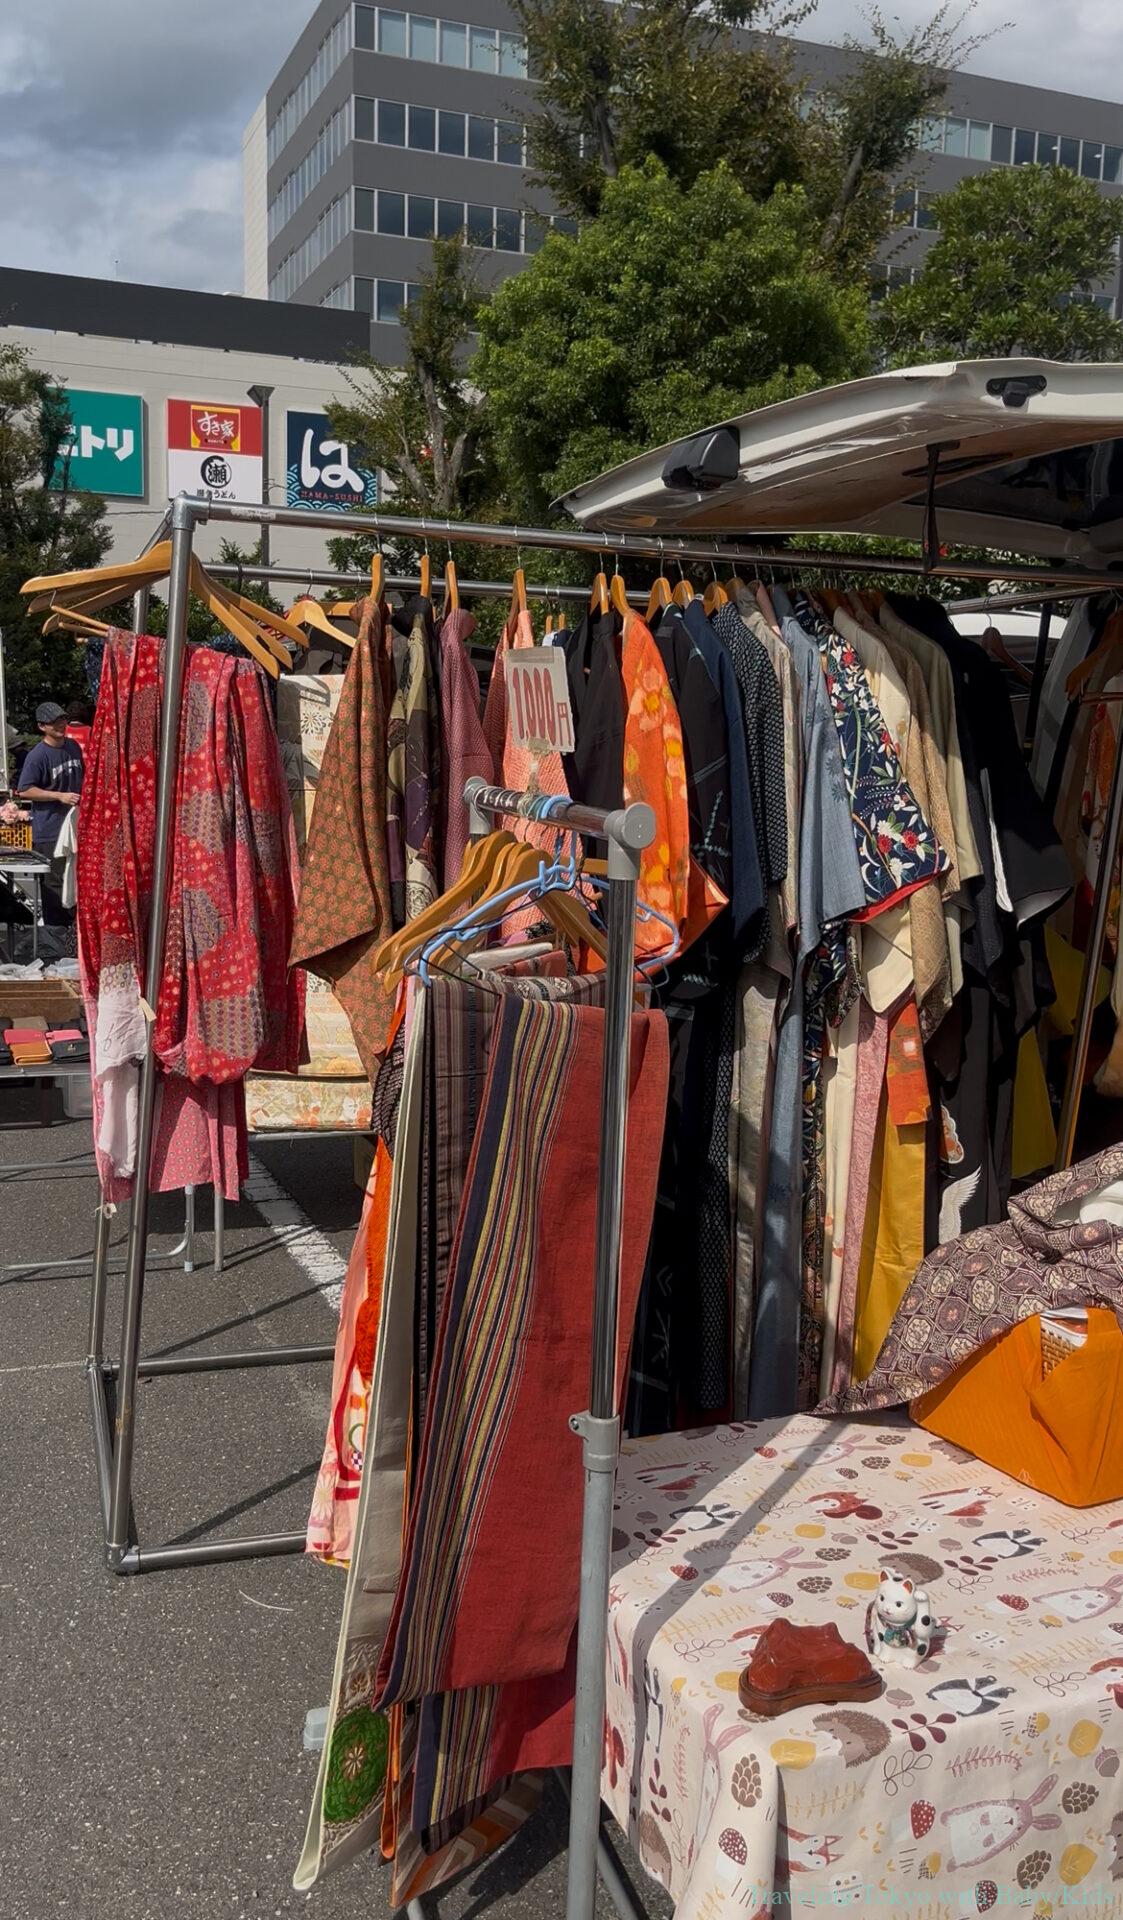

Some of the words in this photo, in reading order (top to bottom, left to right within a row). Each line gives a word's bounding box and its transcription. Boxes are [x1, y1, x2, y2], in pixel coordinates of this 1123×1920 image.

[197, 411, 235, 440] すき家
[301, 428, 365, 493] は
